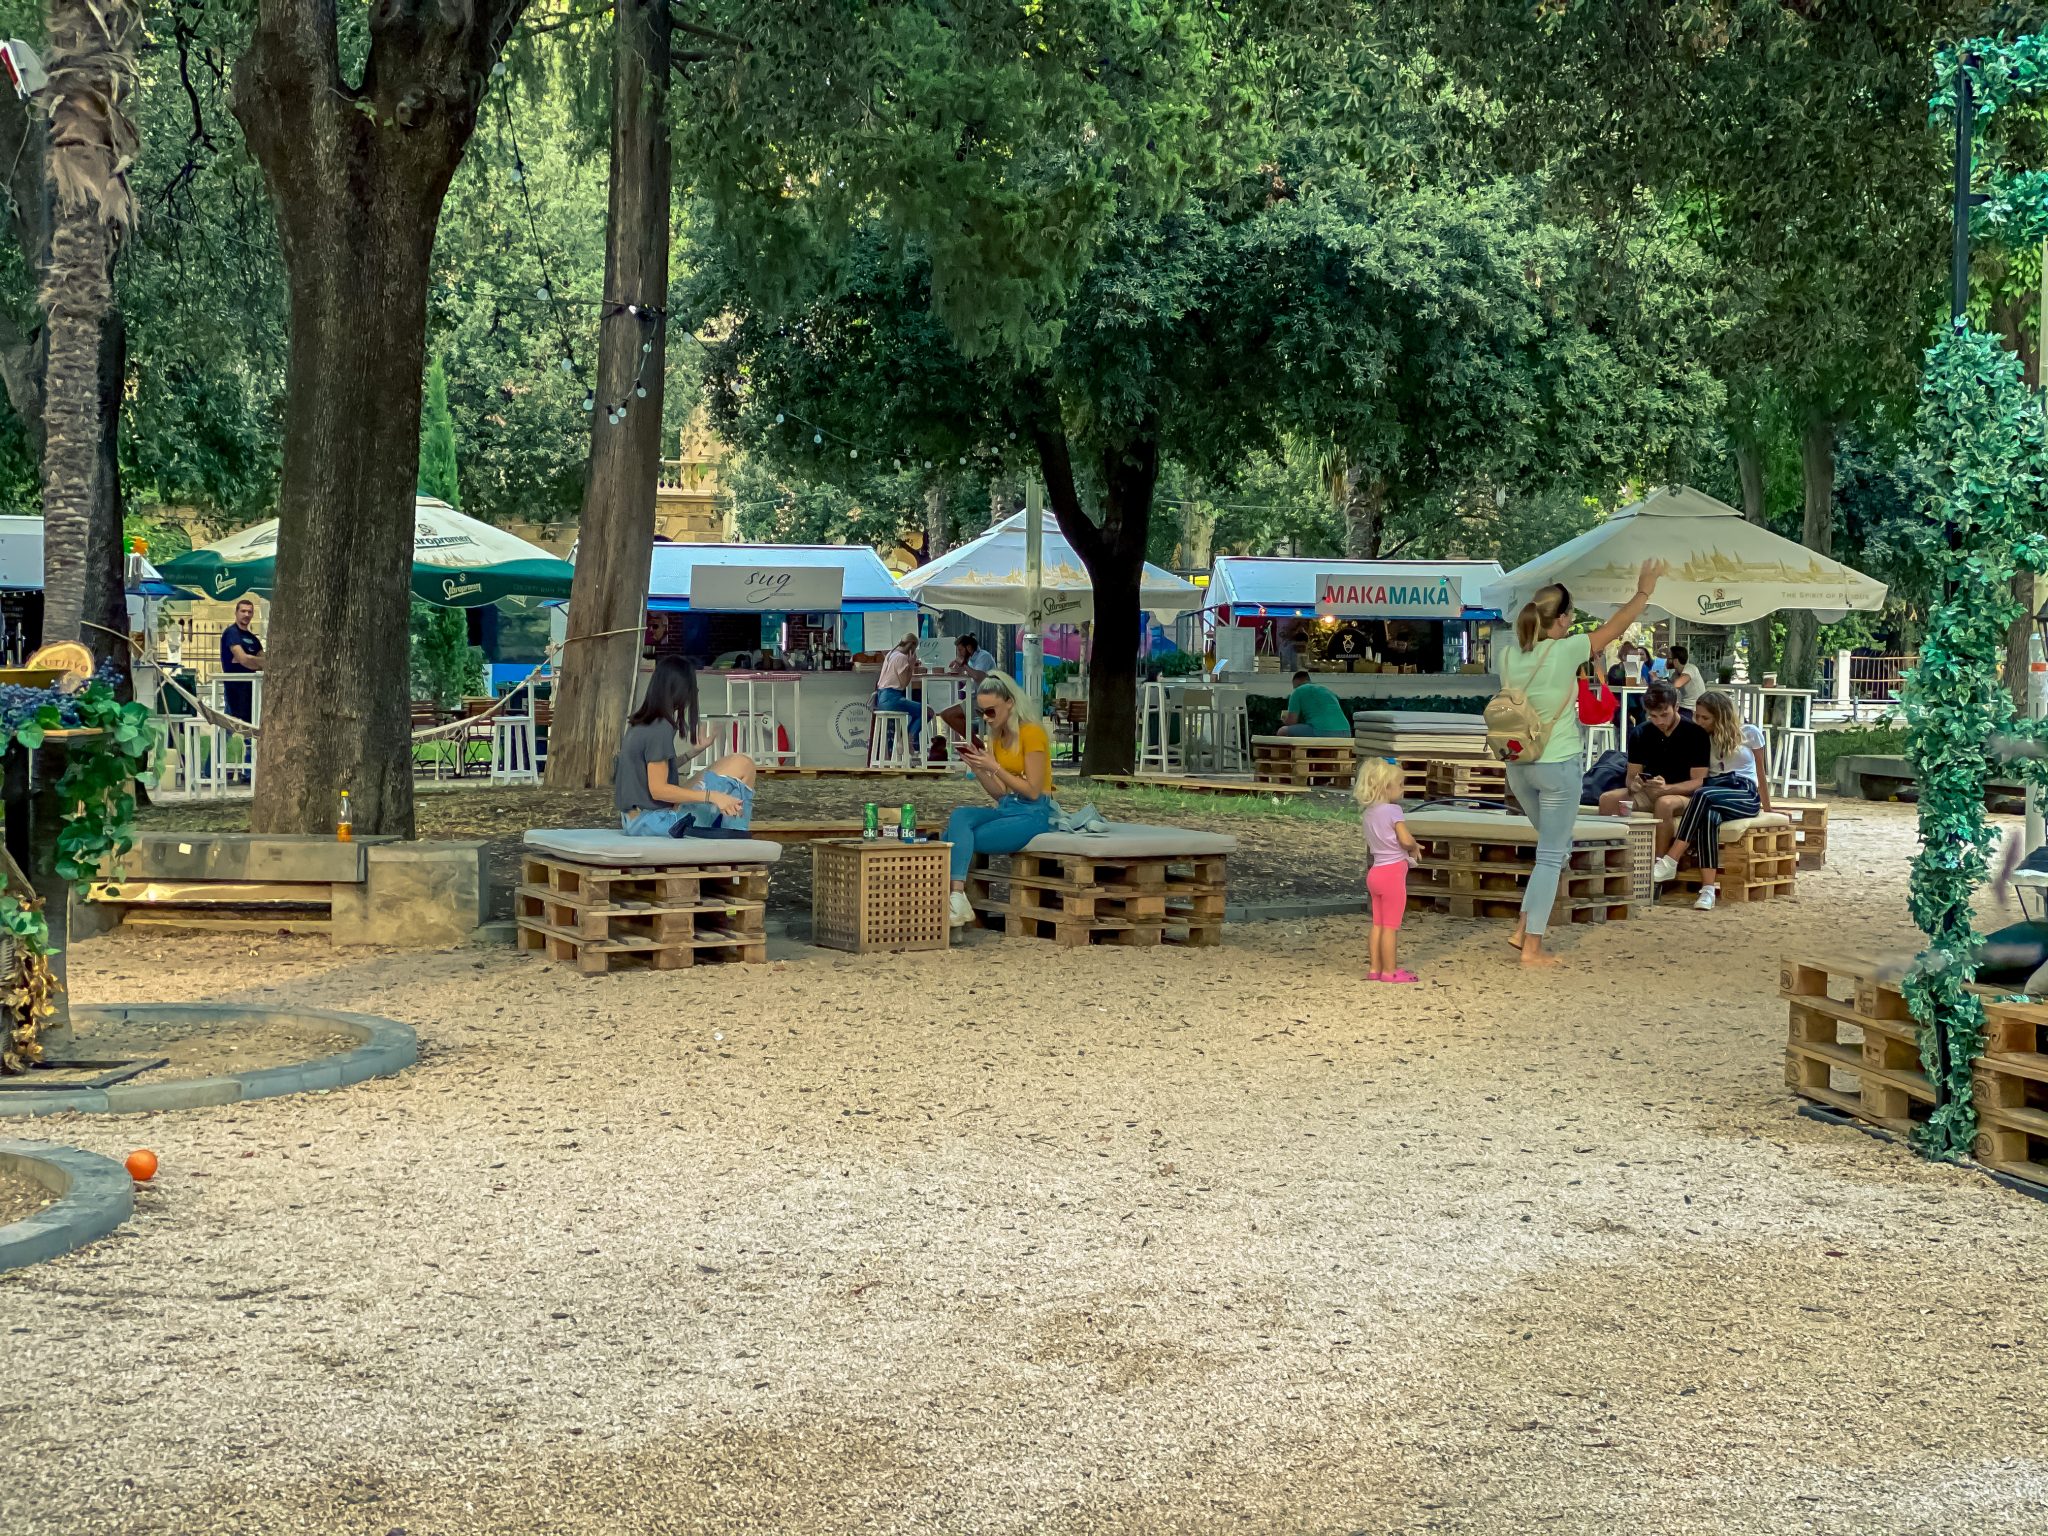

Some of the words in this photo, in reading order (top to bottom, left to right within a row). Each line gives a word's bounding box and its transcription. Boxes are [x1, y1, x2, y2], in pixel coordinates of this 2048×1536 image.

[414, 535, 478, 549] aropramen
[459, 573, 466, 582] S
[744, 571, 795, 604] sug
[1715, 588, 1724, 598] S
[1781, 591, 1796, 599] THE
